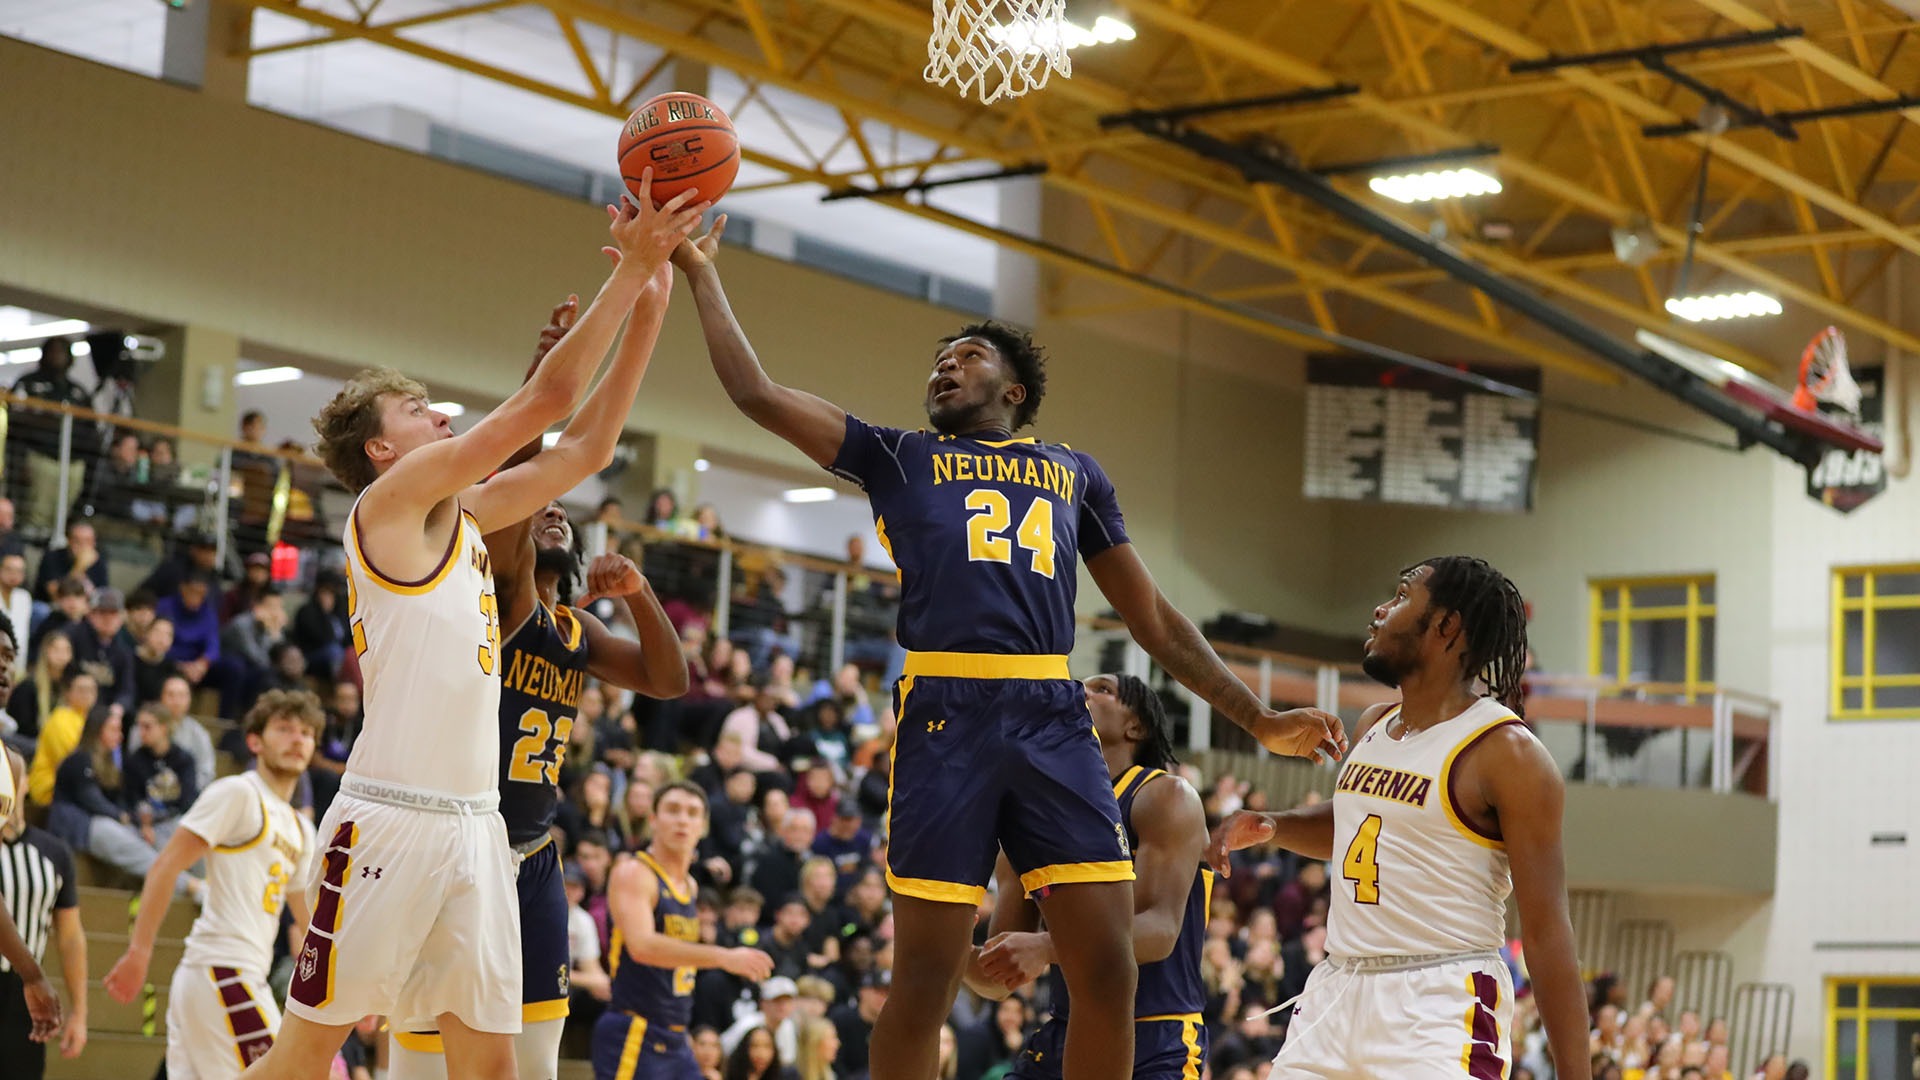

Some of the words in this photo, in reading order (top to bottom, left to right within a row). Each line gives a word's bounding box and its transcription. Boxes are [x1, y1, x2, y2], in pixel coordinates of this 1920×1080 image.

[628, 106, 661, 138] THE
[666, 101, 719, 122] ROCK
[932, 453, 1075, 506] NEUMANN
[964, 488, 1056, 580] 24
[508, 707, 574, 786] 23
[1337, 763, 1433, 807] ALVERNIA
[1343, 813, 1382, 905] 4
